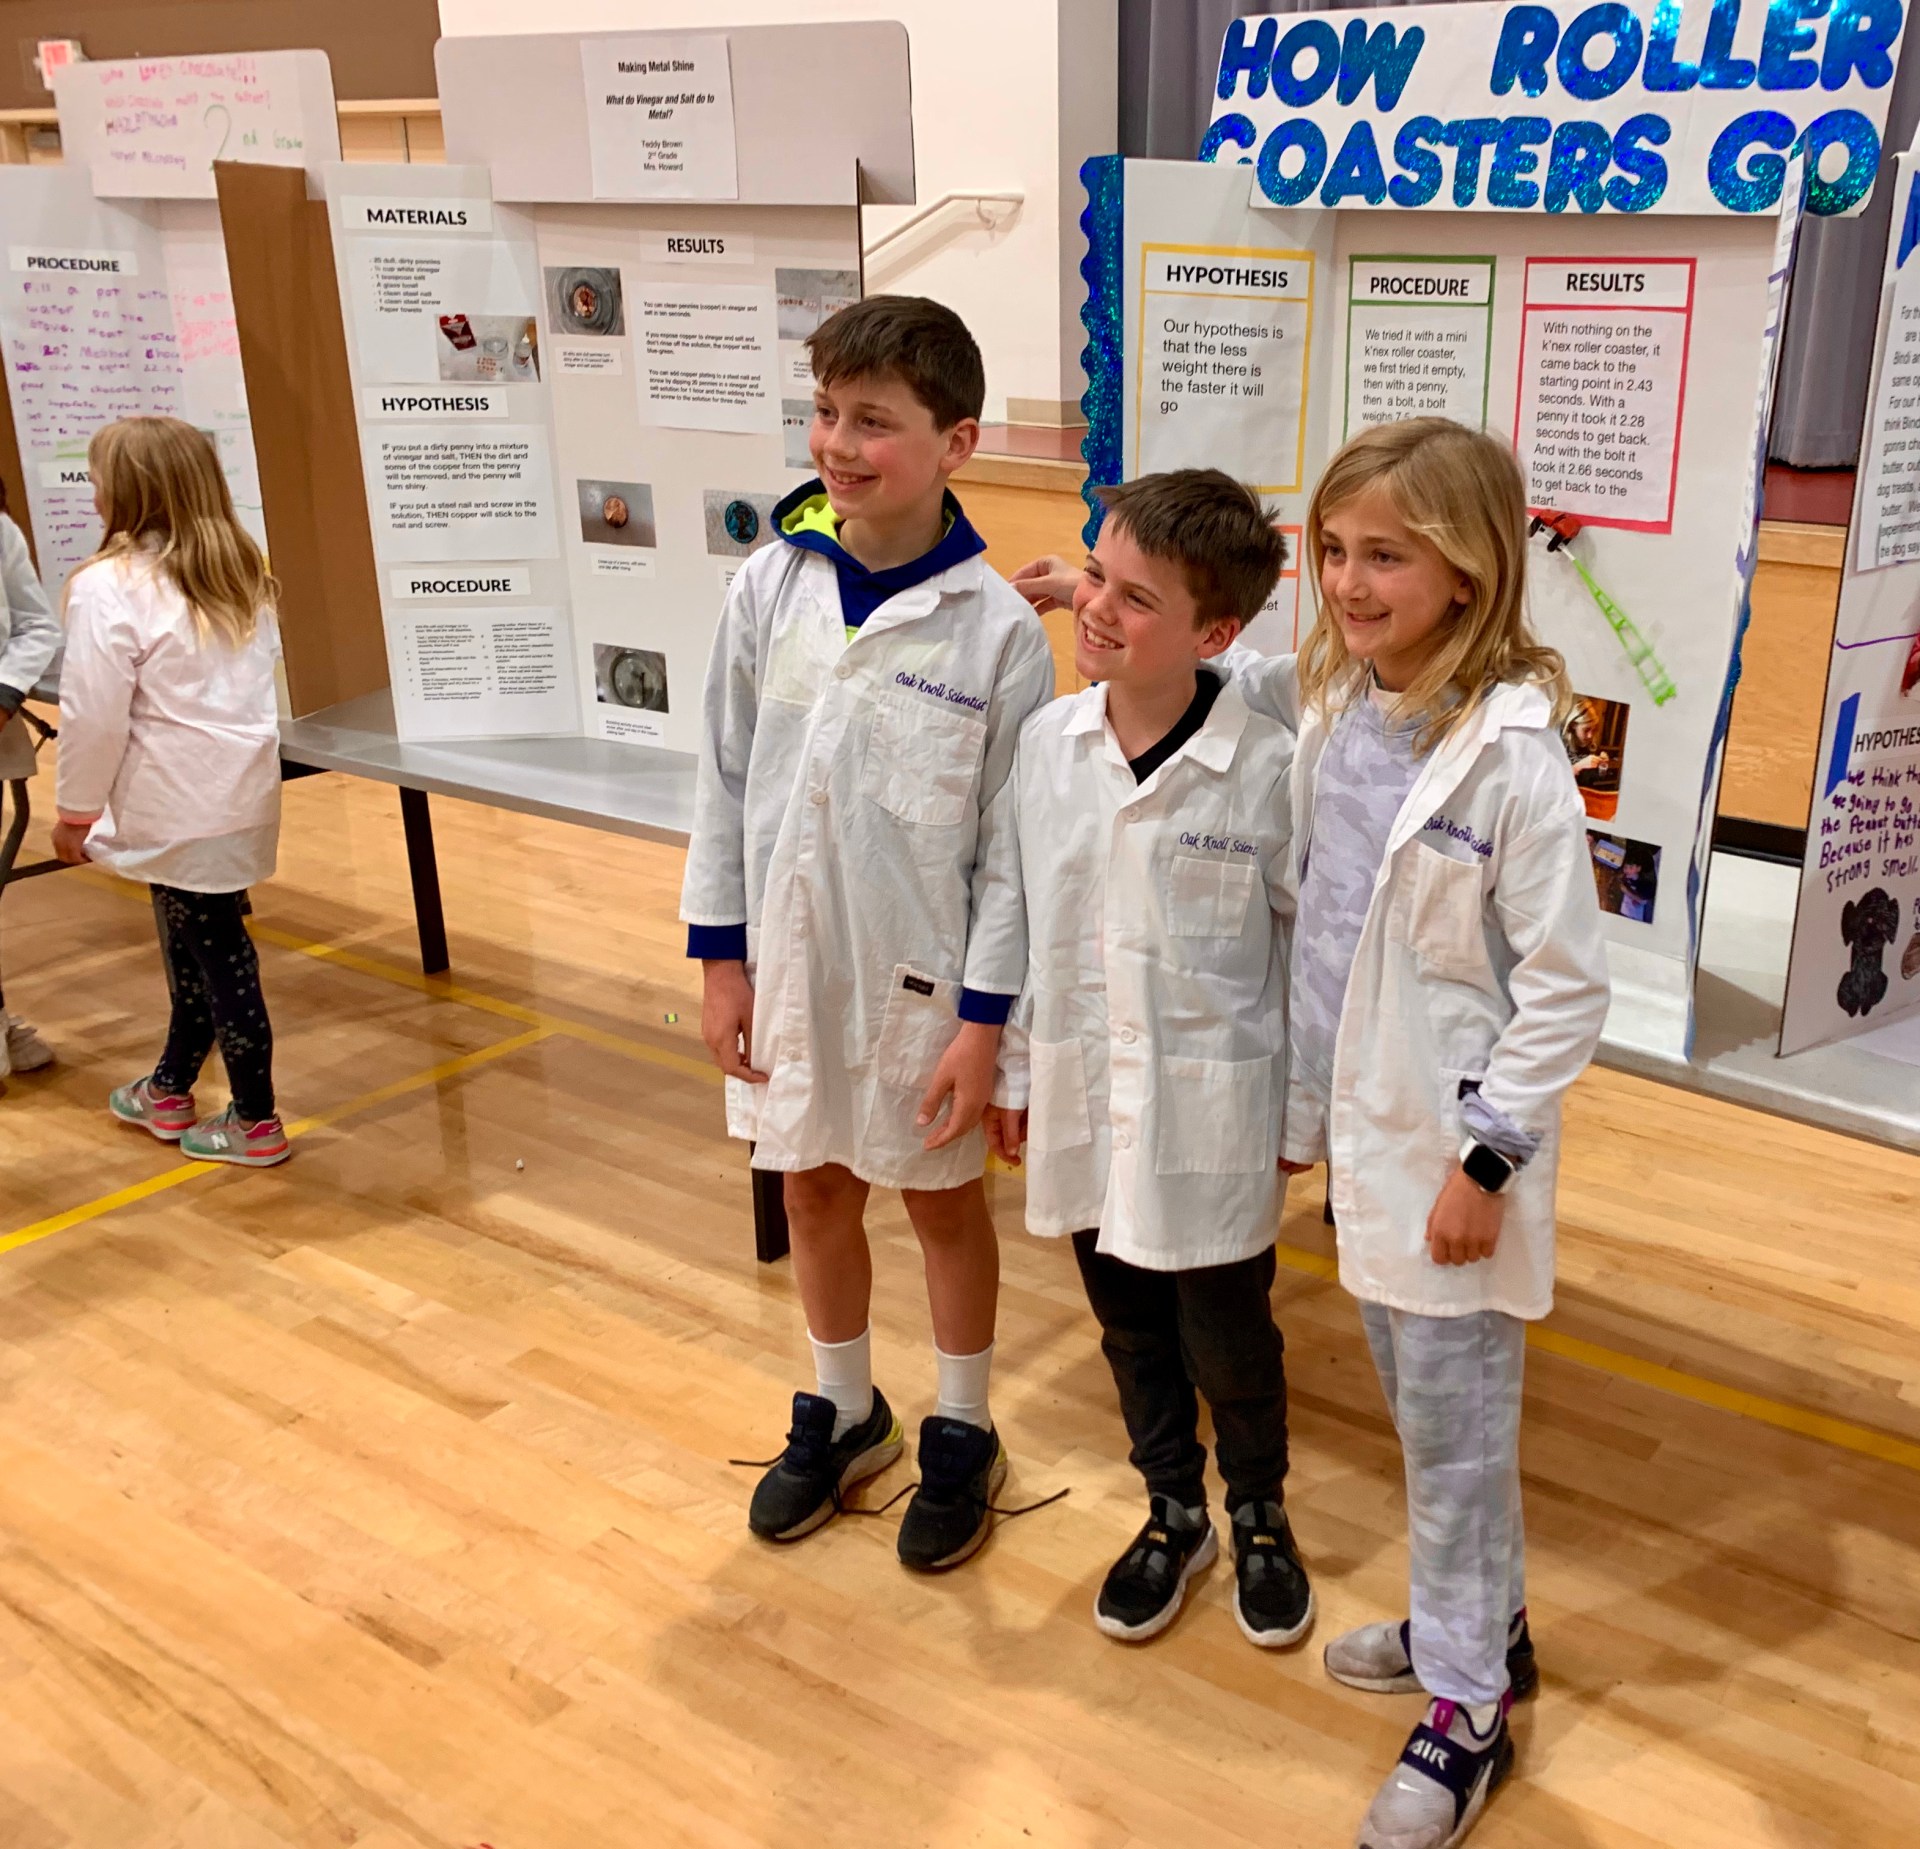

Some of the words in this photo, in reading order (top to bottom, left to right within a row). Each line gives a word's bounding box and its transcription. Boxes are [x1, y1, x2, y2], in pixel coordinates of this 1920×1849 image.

[1216, 17, 1426, 112] HOW
[1490, 0, 1903, 101] ROLLER
[618, 62, 646, 74] Making
[649, 61, 670, 72] Metal
[672, 60, 694, 71] Shine
[606, 95, 624, 105] What
[626, 95, 634, 105] do
[637, 94, 663, 105] Vinegar
[665, 94, 678, 104] and
[680, 93, 694, 104] Salt
[696, 93, 705, 103] do
[707, 94, 714, 103] to
[649, 109, 673, 119] Metal?
[642, 140, 660, 149] Teddy
[662, 140, 683, 148] Brown
[659, 163, 683, 171] Howard
[1198, 112, 1672, 214] COASTERS
[1707, 108, 1882, 216] GO
[367, 209, 467, 225] MATERIALS
[667, 238, 725, 254] RESULTS
[27, 256, 120, 272] PROCEDURE
[1167, 265, 1288, 288] HYPOTHESIS
[1566, 273, 1645, 292] RESULTS
[1370, 277, 1470, 296] PROCEDURE
[1164, 319, 1190, 333] Our
[1194, 321, 1268, 339] hypothesis
[1272, 326, 1283, 339] is
[1365, 329, 1380, 340] We
[1382, 329, 1402, 341] tried
[1405, 330, 1411, 341] it
[1415, 330, 1434, 342] with
[1437, 333, 1443, 342] a
[1445, 330, 1467, 342] mini
[1544, 322, 1568, 334] With
[1571, 323, 1613, 339] nothing
[1616, 326, 1630, 336] on
[1633, 325, 1652, 337] the
[1163, 340, 1190, 354] that
[1194, 342, 1216, 355] the
[1220, 343, 1247, 356] less
[1365, 346, 1389, 357] k'nex
[1392, 347, 1415, 358] roller
[1417, 348, 1456, 360] coaster,
[1542, 340, 1572, 352] k'nex
[1574, 341, 1601, 354] roller
[1604, 342, 1649, 357] coaster,
[1653, 344, 1660, 356] it
[1162, 360, 1208, 376] weight
[1212, 362, 1247, 376] there
[1251, 364, 1261, 377] is
[1364, 363, 1377, 373] we
[1380, 362, 1397, 373] first
[1399, 363, 1420, 375] tried
[1423, 365, 1429, 375] it
[1431, 366, 1466, 378] empty,
[1541, 360, 1570, 370] came
[1573, 359, 1600, 371] back
[1603, 362, 1615, 372] to
[1618, 361, 1636, 373] the
[1161, 380, 1183, 392] the
[1187, 380, 1226, 395] faster
[1230, 382, 1238, 395] it
[1243, 384, 1264, 396] will
[1363, 379, 1383, 389] then
[1386, 380, 1405, 390] with
[1408, 382, 1413, 390] a
[1416, 382, 1448, 394] penny,
[1539, 376, 1579, 390] starting
[1582, 378, 1611, 391] point
[1614, 379, 1624, 390] in
[1627, 379, 1652, 392] 2.43
[382, 398, 489, 411] HYPOTHESIS
[1161, 401, 1178, 414] go
[1363, 395, 1382, 405] then
[1387, 397, 1393, 406] a
[1395, 396, 1416, 407] bolt,
[1419, 399, 1424, 408] a
[1427, 398, 1446, 408] bolt
[1538, 393, 1585, 406] seconds.
[1590, 395, 1615, 408] With
[1618, 399, 1625, 408] a
[1362, 412, 1393, 423] weighs
[1537, 412, 1569, 424] penny
[1572, 410, 1578, 422] it
[1582, 412, 1606, 425] took
[1609, 413, 1618, 426] it
[1620, 416, 1645, 428] 2.28
[1536, 428, 1580, 441] seconds
[1583, 430, 1593, 441] to
[1597, 430, 1616, 445] get
[1619, 432, 1650, 445] back.
[392, 444, 406, 452] you
[431, 443, 447, 451] dirty
[1534, 444, 1555, 456] And
[1558, 445, 1580, 458] with
[1583, 448, 1601, 459] the
[1604, 448, 1626, 461] bolt
[1629, 450, 1636, 462] it
[1532, 461, 1555, 473] took
[1559, 462, 1566, 473] it
[1568, 463, 1592, 476] 2.66
[1596, 465, 1643, 481] seconds
[1532, 478, 1542, 488] to
[1545, 479, 1563, 491] get
[1566, 480, 1591, 493] back
[1595, 483, 1606, 495] to
[1609, 484, 1627, 496] the
[1531, 495, 1557, 506] start.
[411, 579, 511, 593] PROCEDURE
[896, 672, 917, 687] Oak
[918, 679, 945, 698] Knoll
[1872, 767, 1901, 787] think
[1848, 794, 1880, 814] going
[1885, 796, 1895, 811] to
[1900, 796, 1912, 814] go
[1423, 815, 1446, 830] Oak
[1446, 820, 1472, 842] Knoll
[1821, 817, 1840, 836] the
[1180, 832, 1200, 850] Oak
[1202, 835, 1231, 850] Knoll
[1819, 839, 1871, 869] Because
[1878, 831, 1890, 853] it
[1408, 1739, 1450, 1770] AIR
